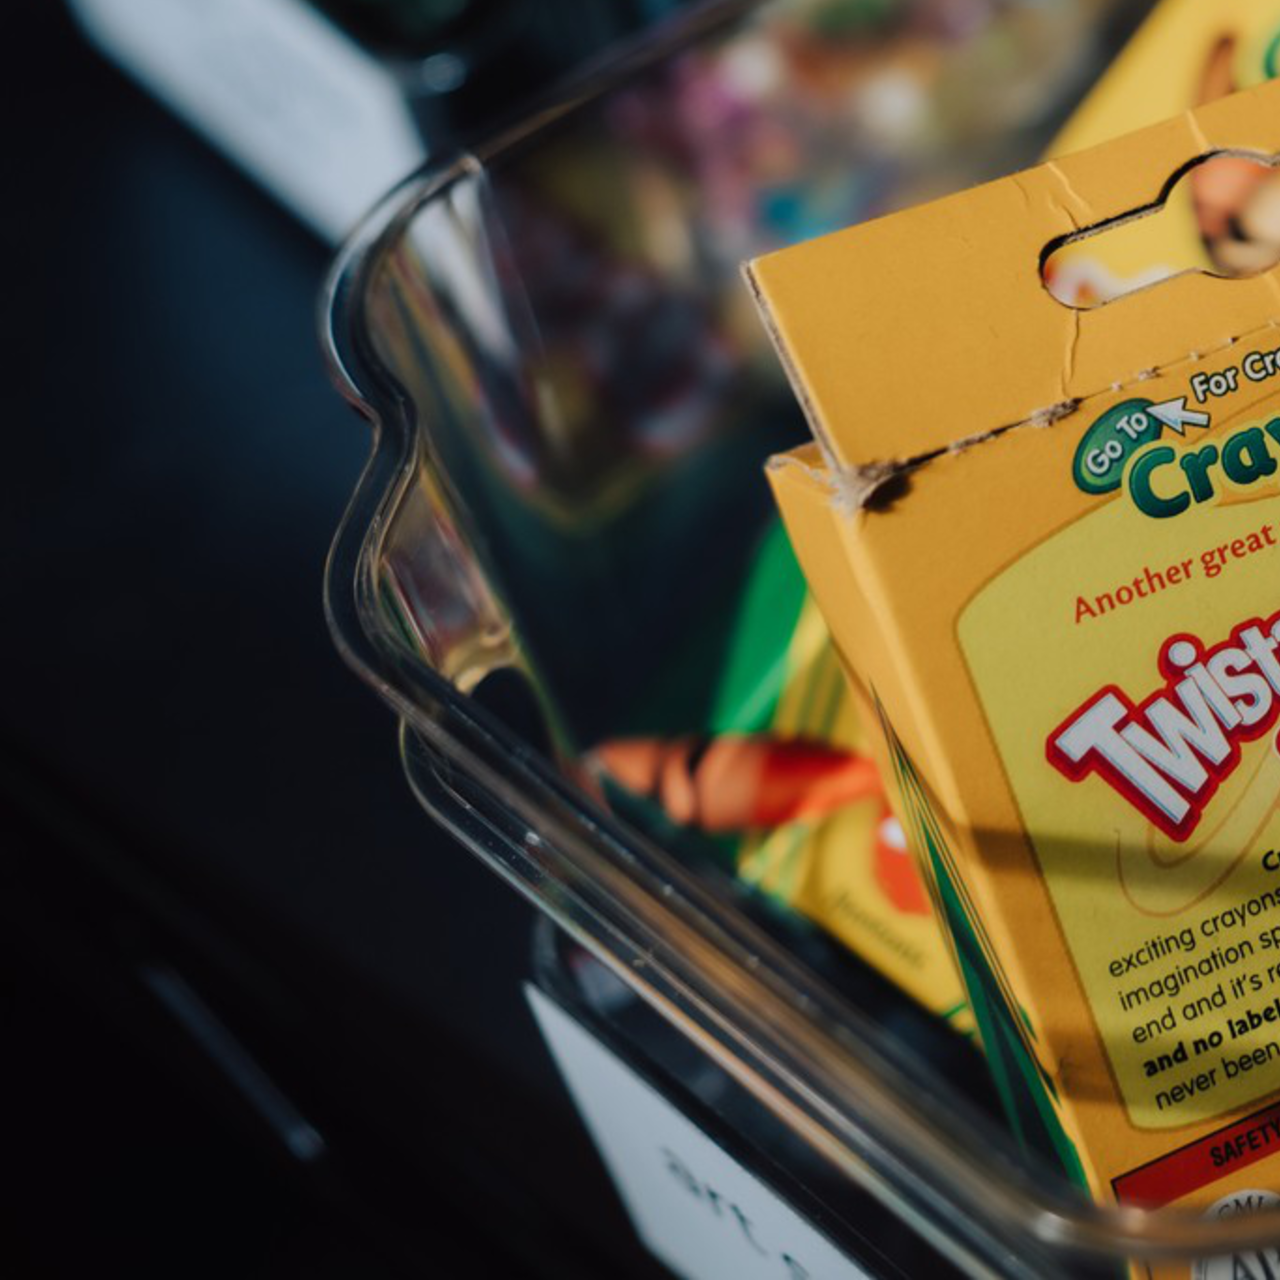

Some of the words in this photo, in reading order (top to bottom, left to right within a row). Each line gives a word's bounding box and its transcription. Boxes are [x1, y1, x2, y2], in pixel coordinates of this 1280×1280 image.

[1191, 365, 1238, 403] For
[1086, 439, 1123, 475] Go
[1117, 408, 1150, 440] To
[1074, 557, 1193, 624] Another
[1200, 523, 1278, 578] great
[1108, 927, 1196, 979] exciting
[1118, 940, 1255, 1012] imagination
[1132, 1006, 1178, 1045] end
[1182, 984, 1228, 1021] and
[1230, 972, 1264, 1001] it's
[1143, 1040, 1189, 1078] and
[1193, 1030, 1224, 1055] no
[1155, 1069, 1218, 1111] never
